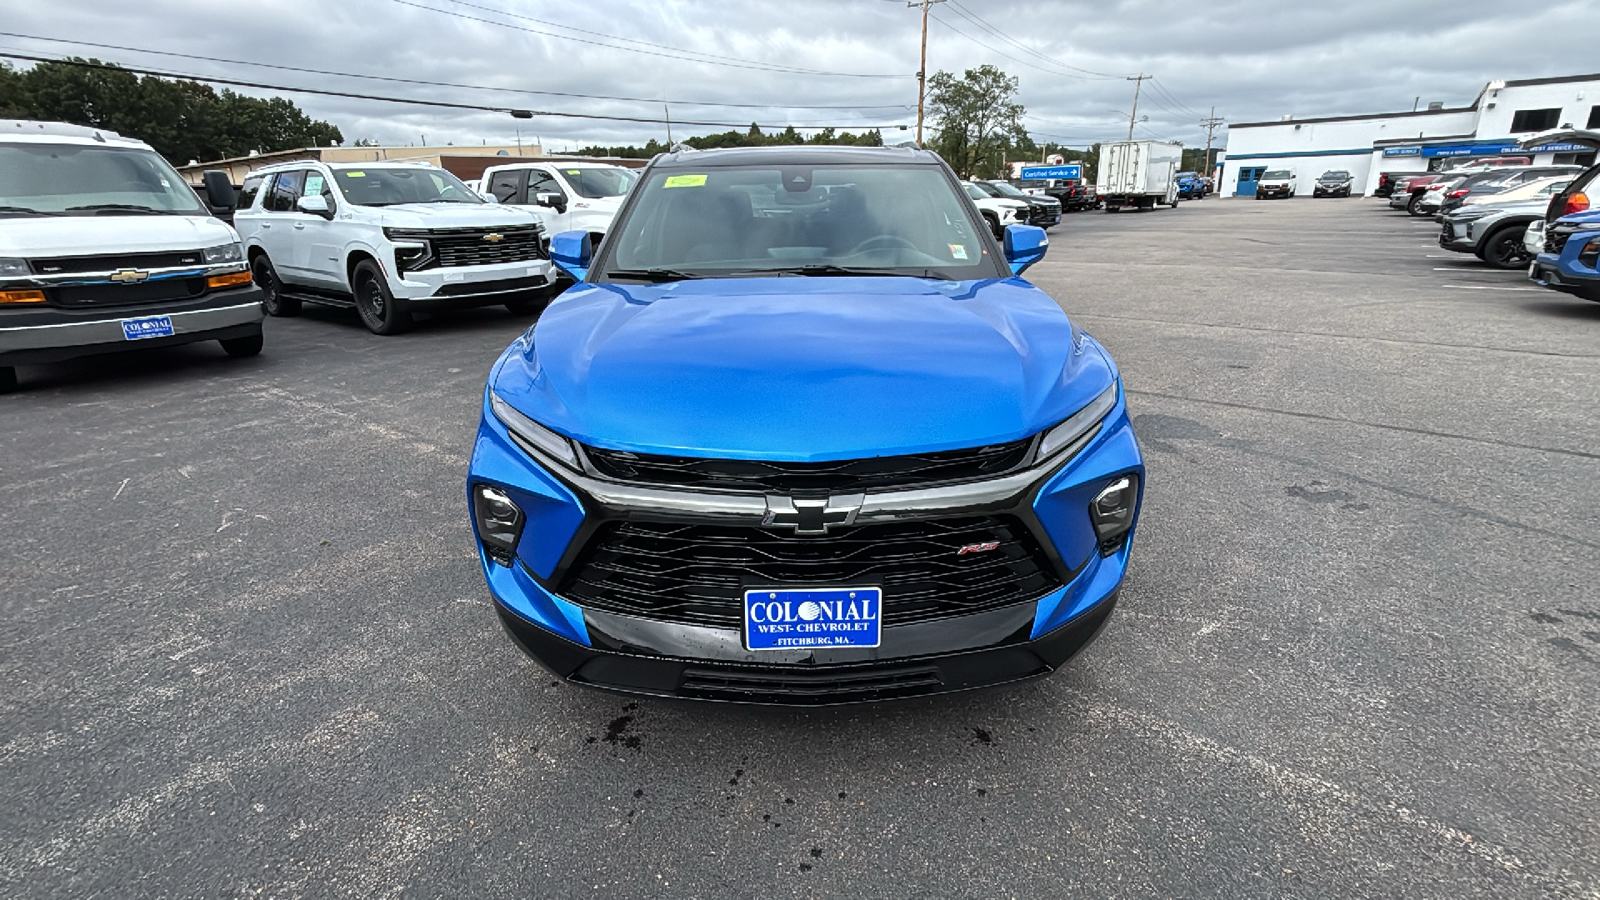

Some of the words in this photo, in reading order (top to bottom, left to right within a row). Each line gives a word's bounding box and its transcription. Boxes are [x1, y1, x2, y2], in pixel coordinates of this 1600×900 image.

[957, 541, 1000, 556] RS
[750, 600, 876, 622] COLONIAL
[758, 624, 794, 634] WEST-
[796, 622, 870, 633] CHEVROLET
[777, 637, 833, 646] FITCHBURG,
[834, 636, 849, 644] MA
